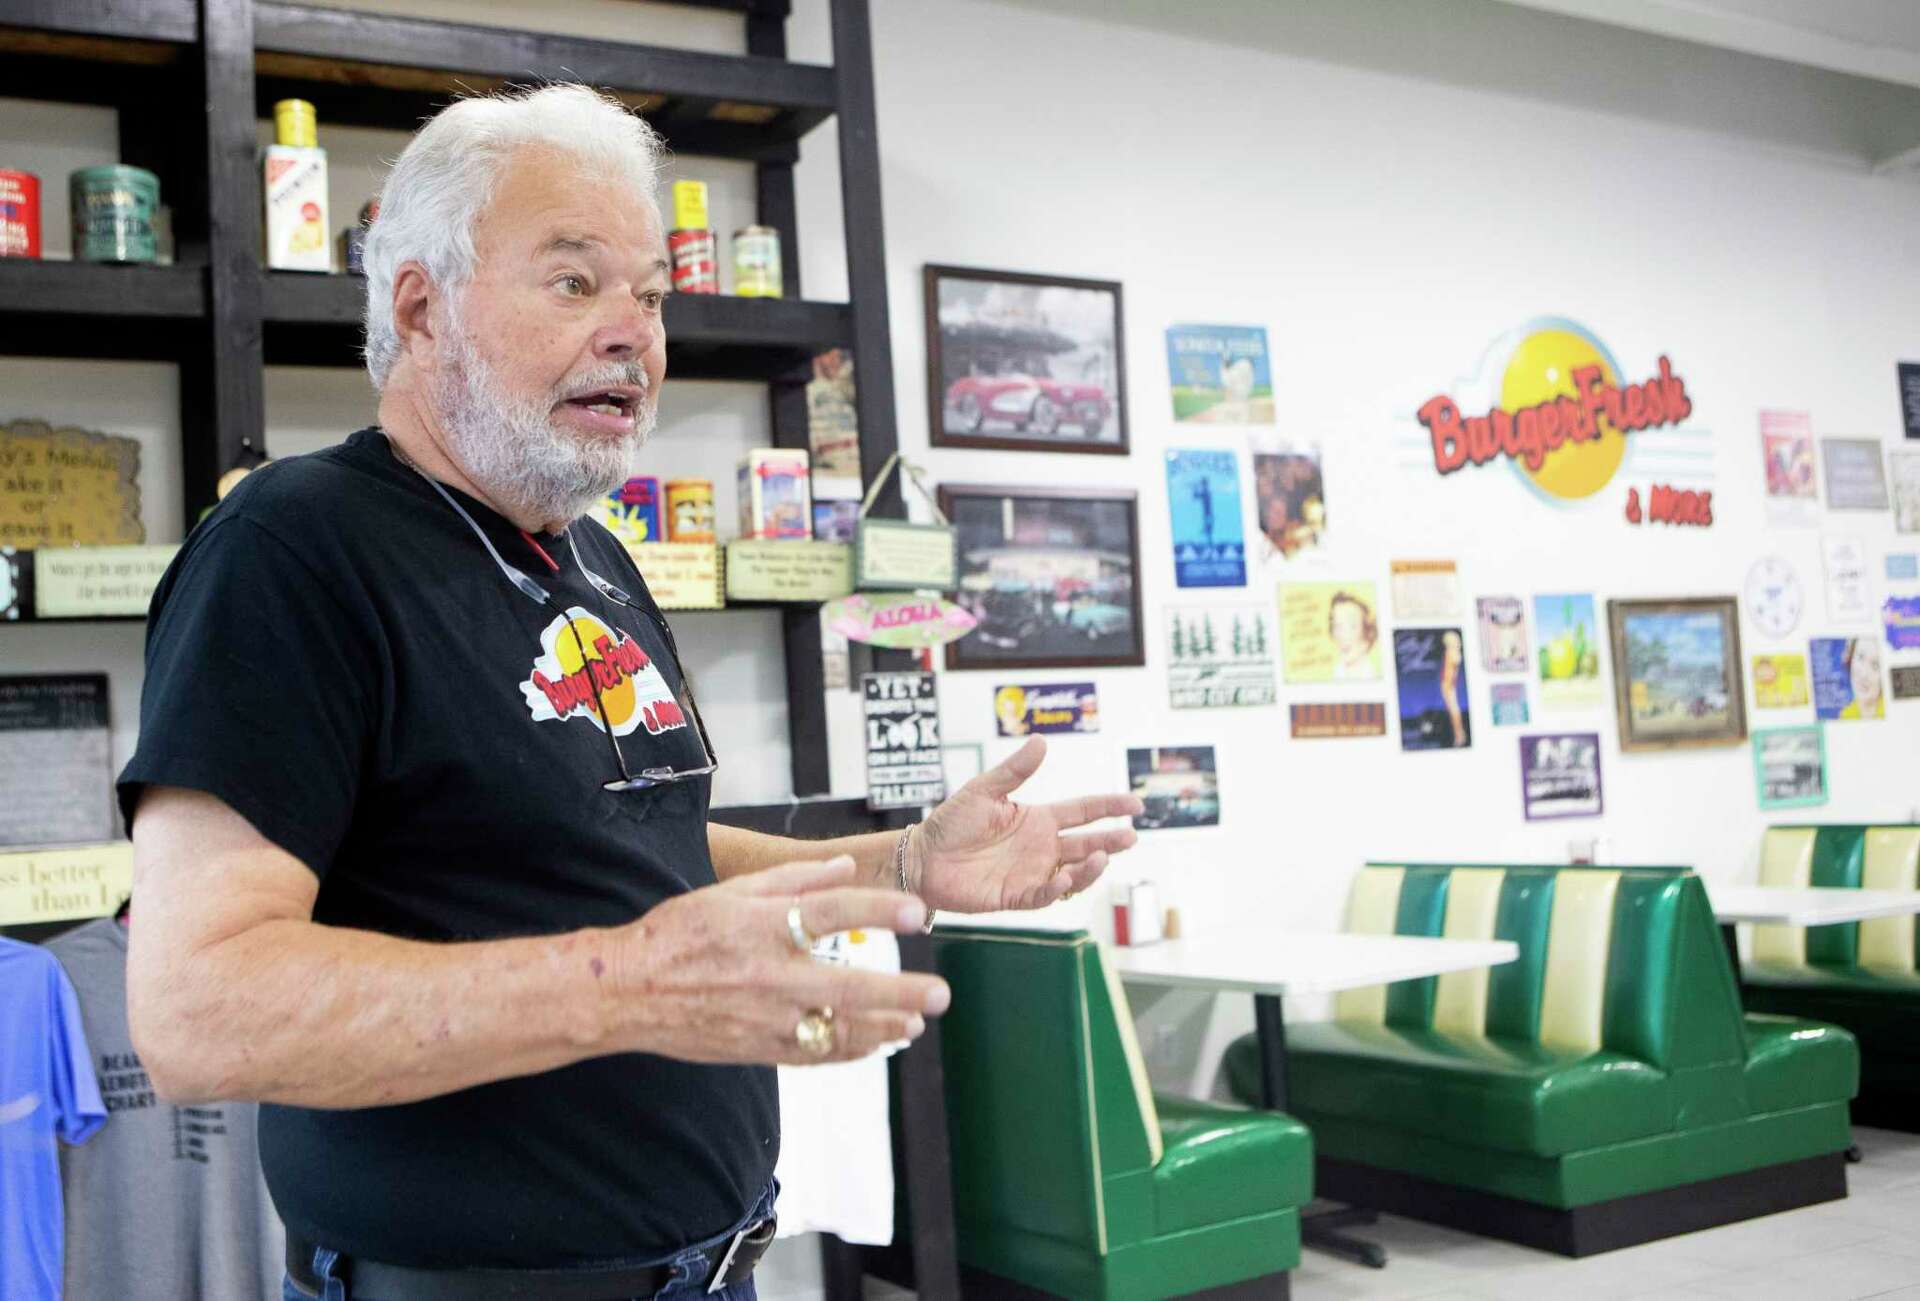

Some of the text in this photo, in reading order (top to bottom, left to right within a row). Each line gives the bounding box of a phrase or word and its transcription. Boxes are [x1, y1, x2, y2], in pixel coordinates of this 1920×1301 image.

[1417, 354, 1692, 476] BurgerFresh
[871, 602, 945, 630] ALOHA
[876, 676, 921, 699] YET
